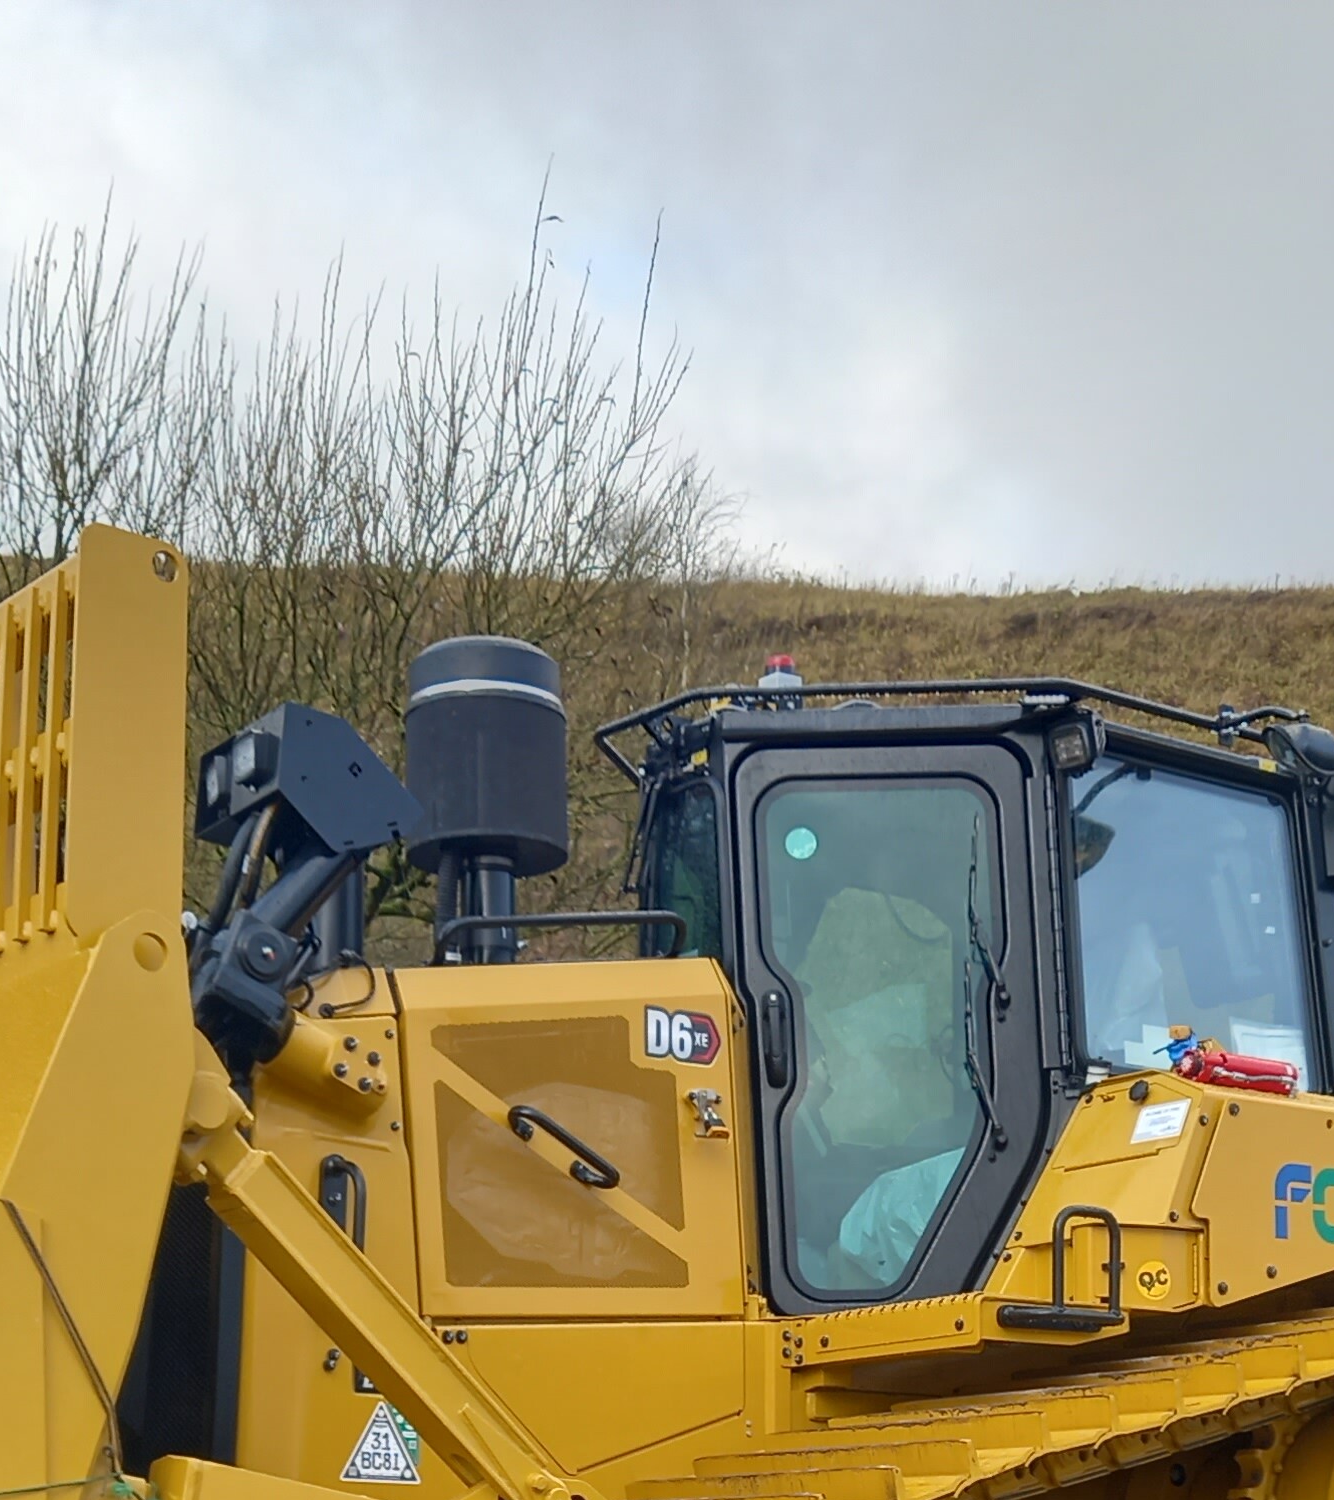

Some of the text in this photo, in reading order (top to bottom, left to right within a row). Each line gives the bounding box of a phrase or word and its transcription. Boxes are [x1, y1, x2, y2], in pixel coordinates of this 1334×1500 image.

[647, 1008, 709, 1059] D6 XE
[1138, 1268, 1169, 1292] QC
[371, 1432, 391, 1450] 31
[361, 1452, 400, 1470] BC81
